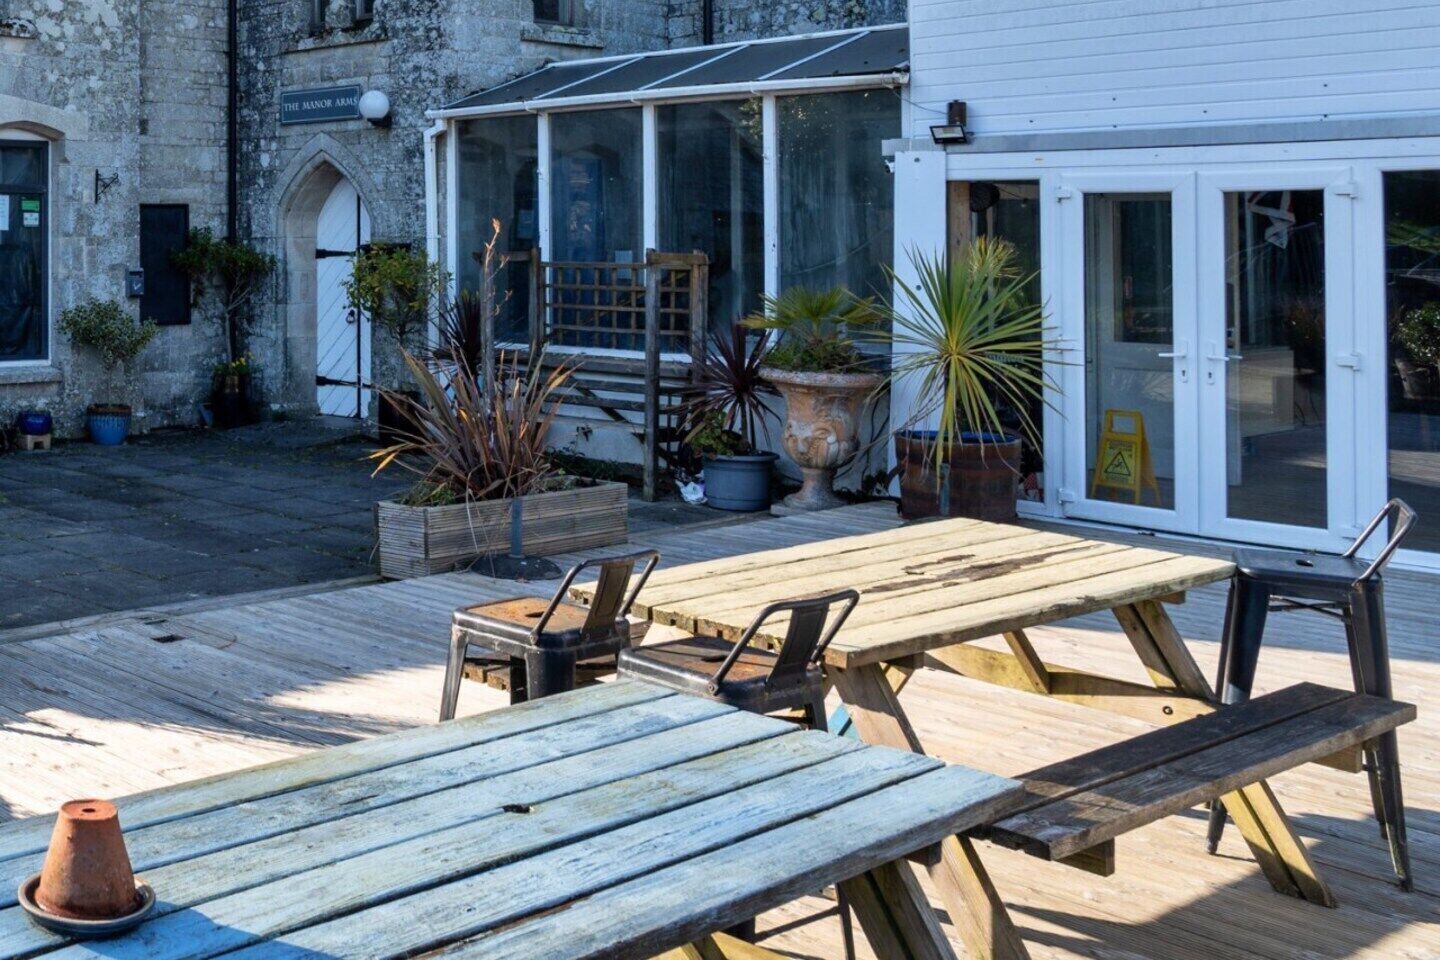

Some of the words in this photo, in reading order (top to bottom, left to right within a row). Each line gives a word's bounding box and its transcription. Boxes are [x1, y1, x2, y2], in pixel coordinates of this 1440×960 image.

[283, 102, 300, 111] THE
[302, 99, 332, 110] MANOR
[335, 97, 358, 107] ARMS
